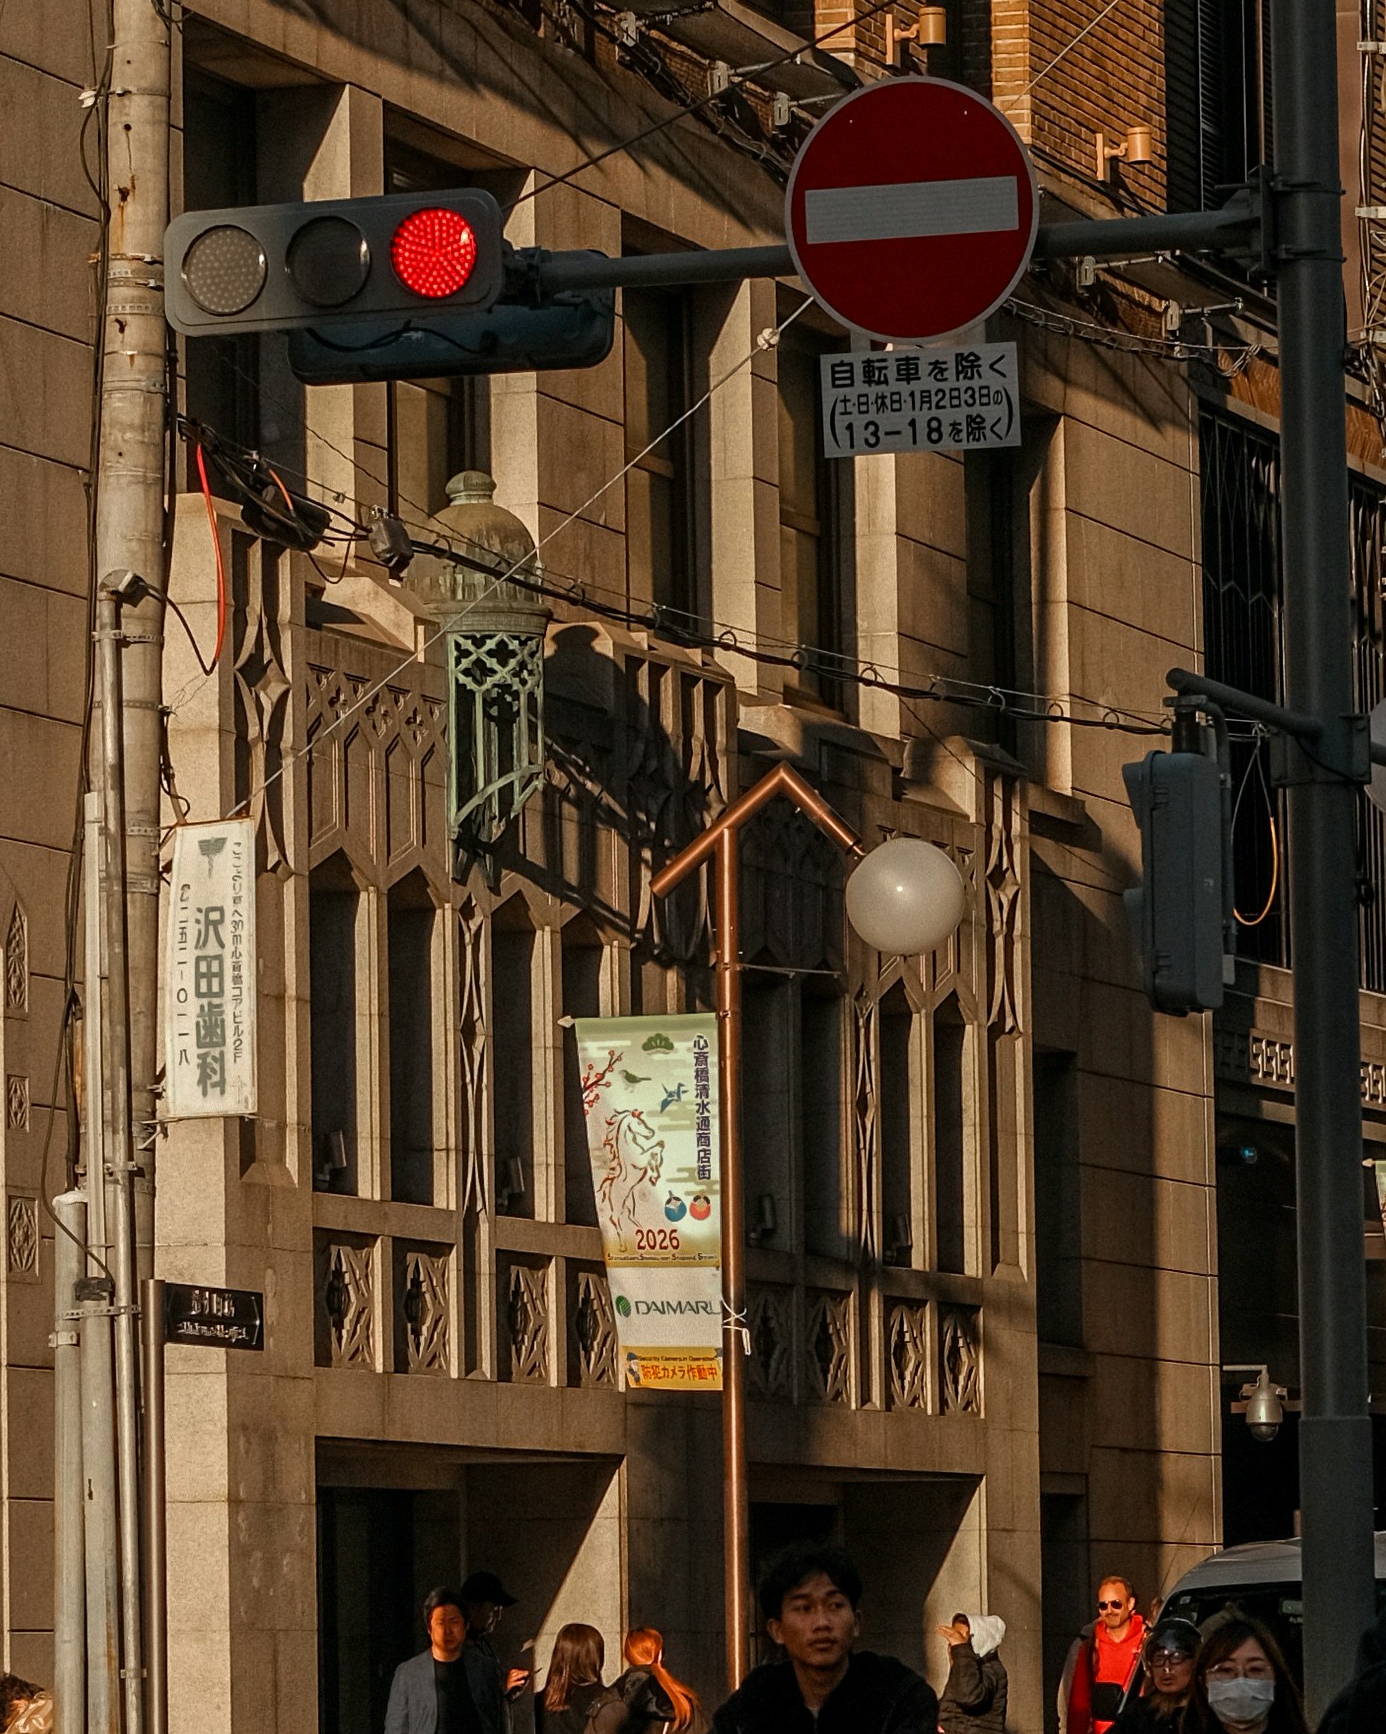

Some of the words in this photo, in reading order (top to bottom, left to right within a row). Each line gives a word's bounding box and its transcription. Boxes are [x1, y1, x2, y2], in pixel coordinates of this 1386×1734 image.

[830, 352, 1007, 388] 自転車を除く
[194, 905, 227, 1098] 沢田歯科
[693, 1034, 712, 1181] 心斎橋清水通商店街
[635, 1229, 680, 1250] 2026
